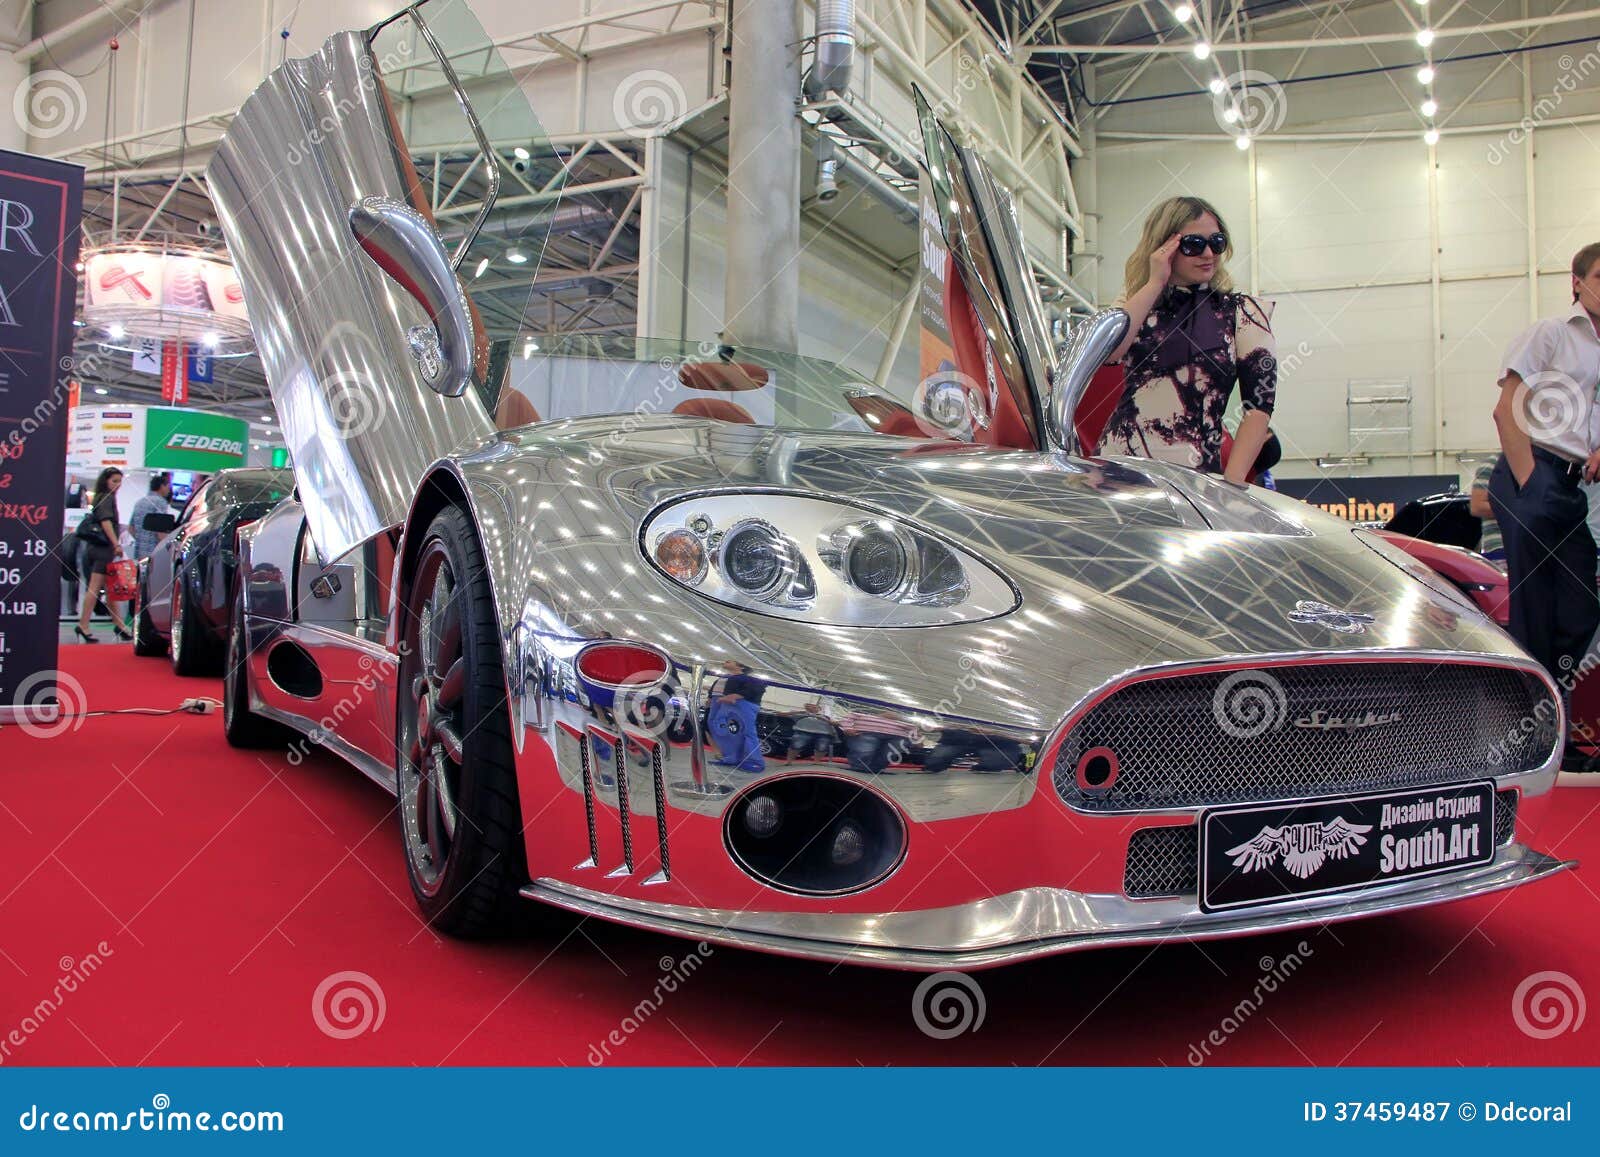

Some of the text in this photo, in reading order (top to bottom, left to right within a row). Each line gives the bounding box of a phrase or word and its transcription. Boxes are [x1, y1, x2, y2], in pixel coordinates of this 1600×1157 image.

[167, 433, 243, 455] FEDERAL
[0, 503, 48, 525] ика
[23, 539, 47, 556] 18
[1380, 795, 1481, 830] Дизайн Студия
[1280, 824, 1322, 857] SOUTH
[1380, 823, 1480, 873] South.Art
